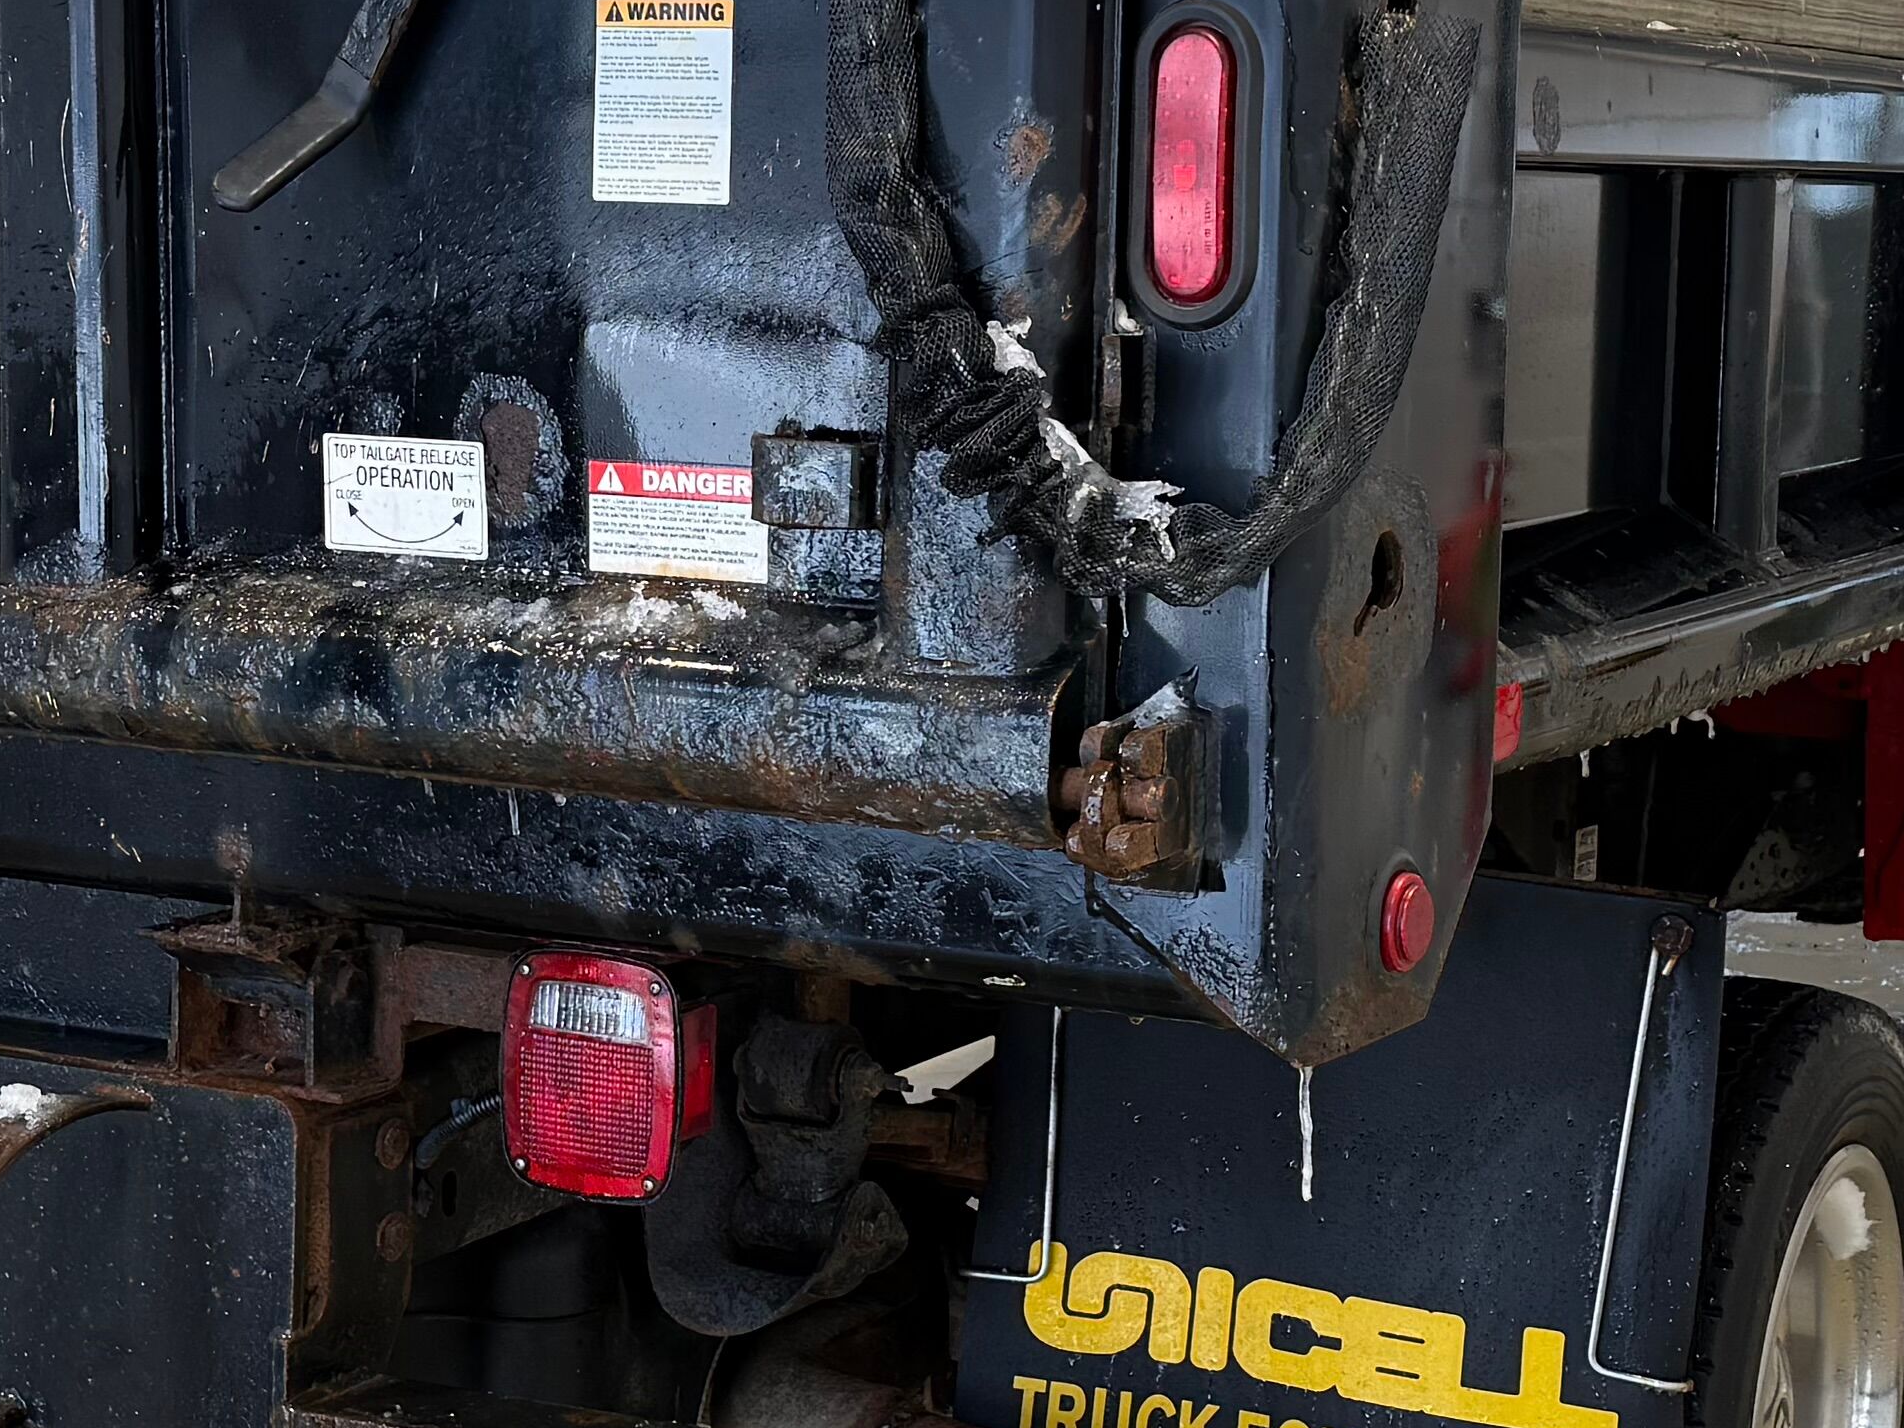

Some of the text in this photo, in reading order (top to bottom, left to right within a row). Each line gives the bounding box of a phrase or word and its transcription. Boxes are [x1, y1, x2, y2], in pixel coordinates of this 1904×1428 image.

[627, 2, 725, 21] WARNING
[334, 443, 476, 467] TOP TAILGATE RELEASE
[356, 465, 454, 492] OPERATION
[642, 469, 752, 497] DANGER
[336, 488, 363, 500] CLOSE
[452, 497, 475, 509] OPEN
